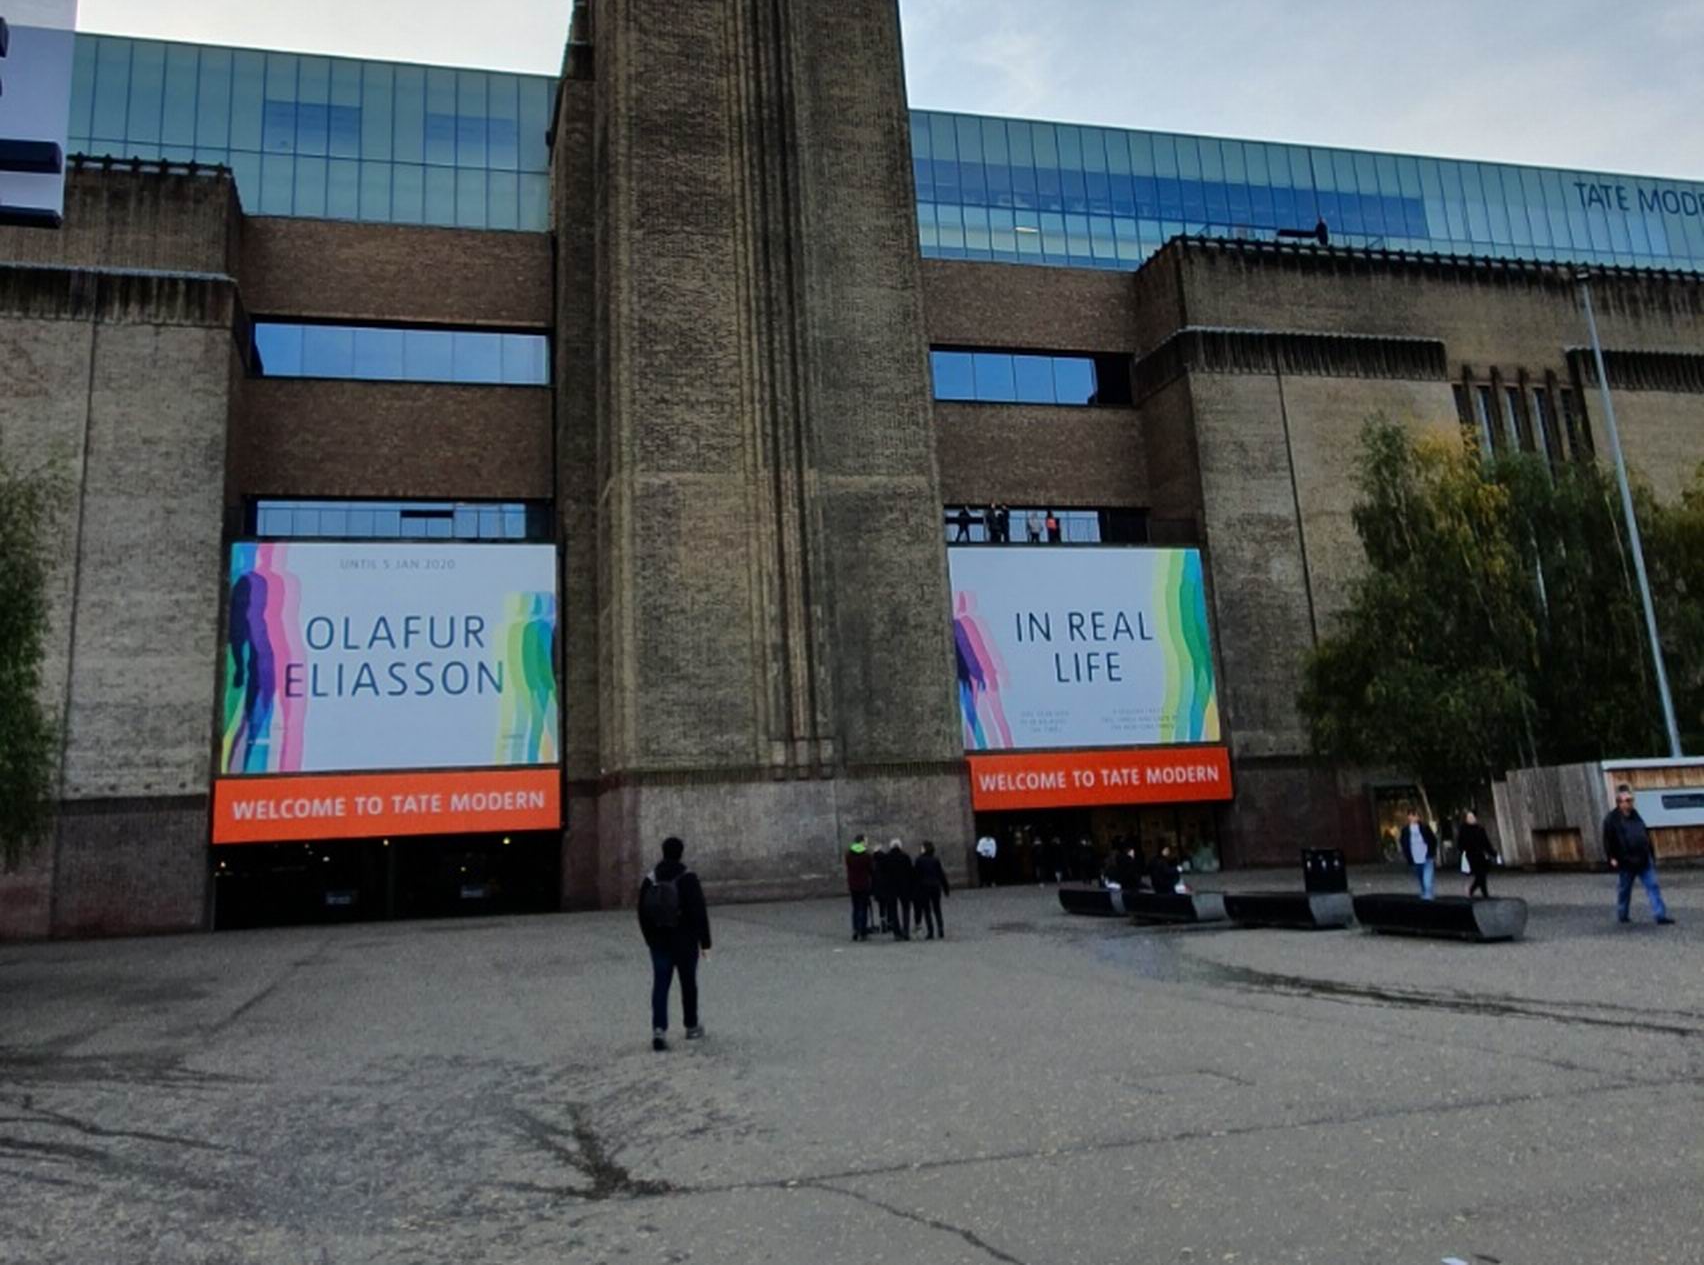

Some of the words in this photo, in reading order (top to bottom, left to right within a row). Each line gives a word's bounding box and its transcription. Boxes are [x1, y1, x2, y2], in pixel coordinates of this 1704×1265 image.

[1573, 182, 1630, 211] TATE
[306, 615, 486, 650] OLAFUR
[1015, 612, 1051, 642] IN
[1069, 611, 1153, 641] REAL
[284, 661, 505, 698] ELIASSON
[1054, 652, 1123, 683] LIFE
[978, 769, 1066, 791] WELCOME
[1072, 768, 1095, 788] TO
[1101, 767, 1140, 787] TATE
[1146, 765, 1219, 785] MODERN
[233, 798, 345, 820] WELCOME
[354, 796, 383, 816] TO
[391, 793, 442, 814] TATE
[450, 790, 545, 811] MODERN
